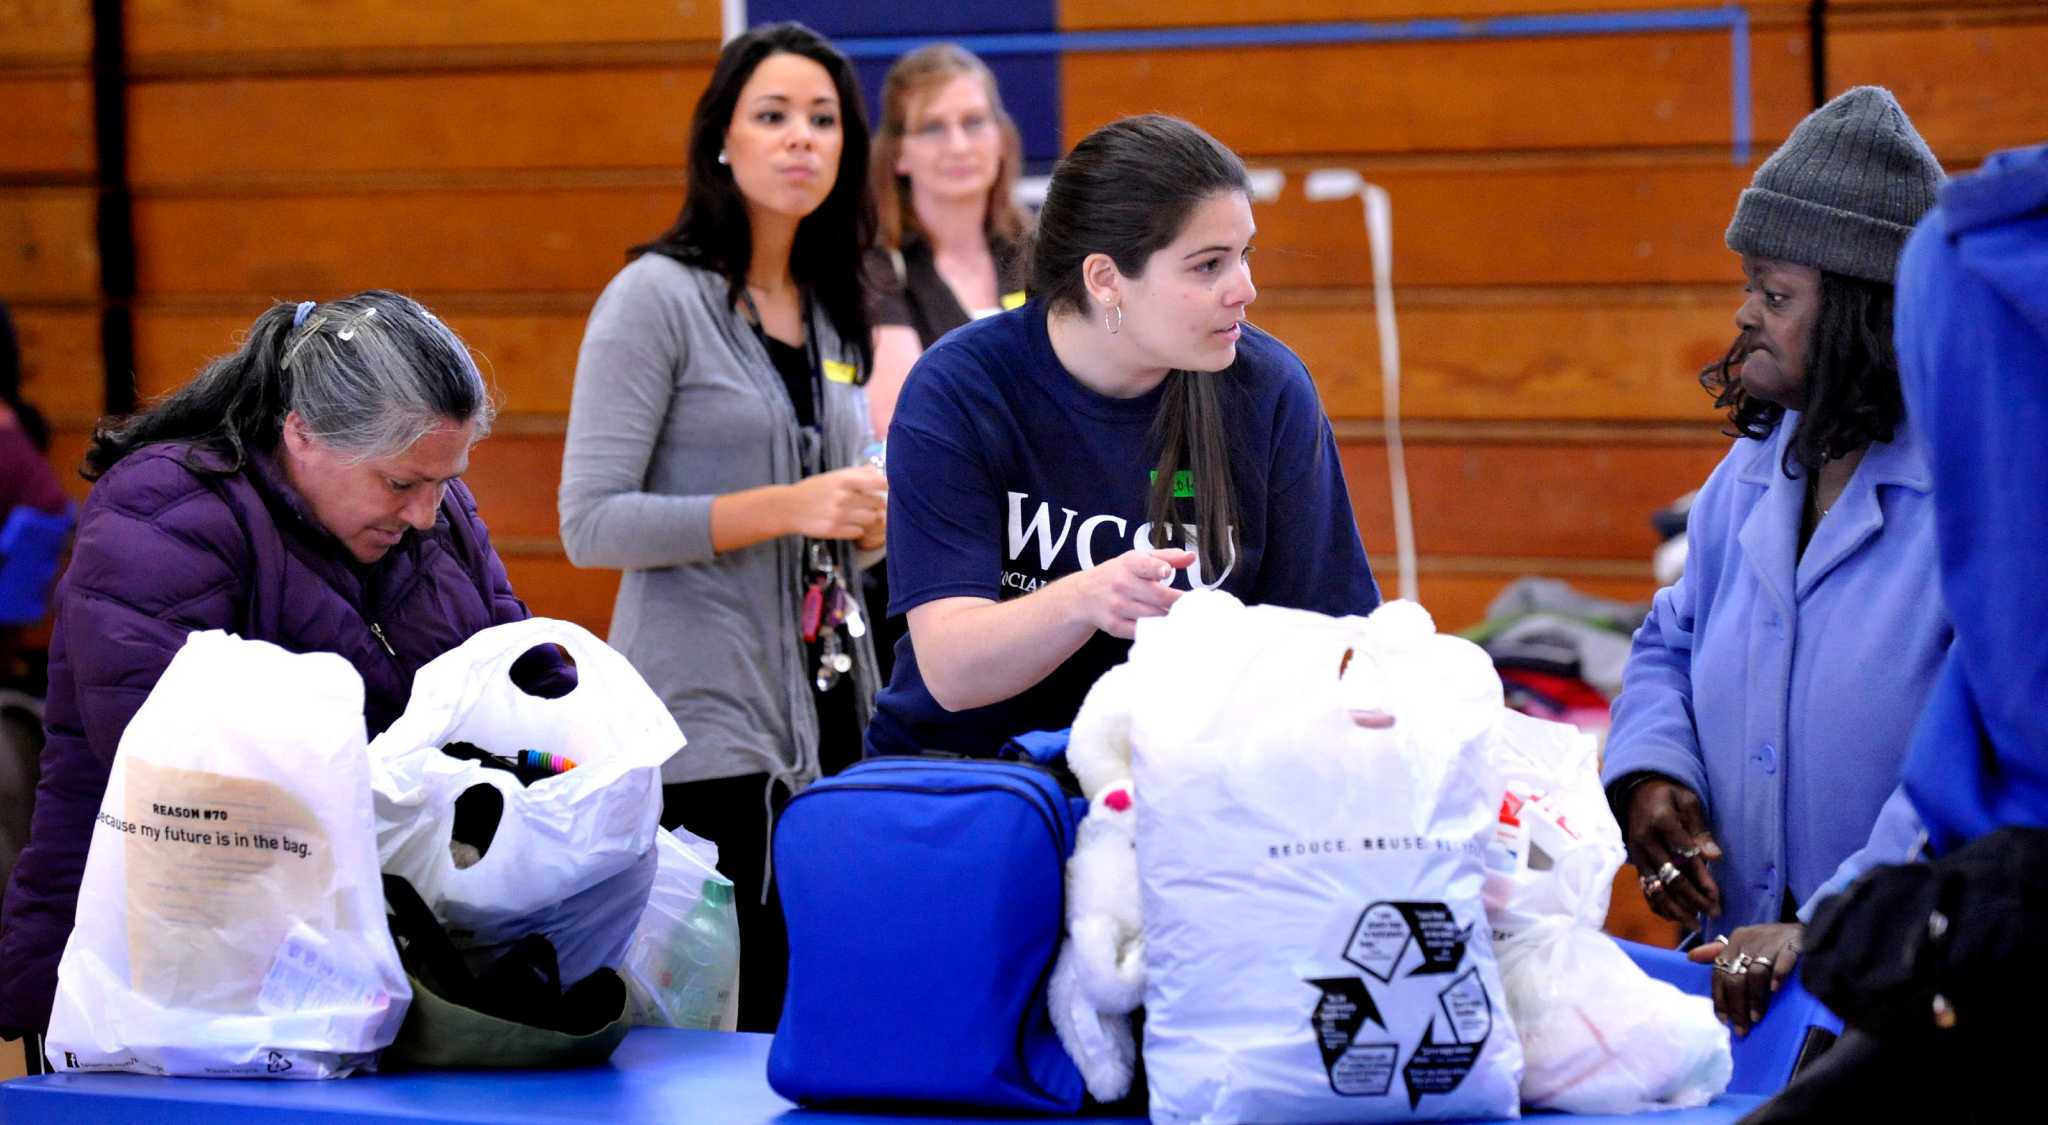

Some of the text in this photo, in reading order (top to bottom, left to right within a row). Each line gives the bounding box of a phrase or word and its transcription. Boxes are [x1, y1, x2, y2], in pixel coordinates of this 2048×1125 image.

[1000, 570, 1048, 592] OCIA
[152, 803, 228, 821] REASON #70
[141, 823, 160, 842] my
[165, 826, 212, 845] future
[216, 831, 230, 846] is
[235, 832, 249, 848] in
[253, 835, 279, 850] the
[283, 837, 312, 858] bag.
